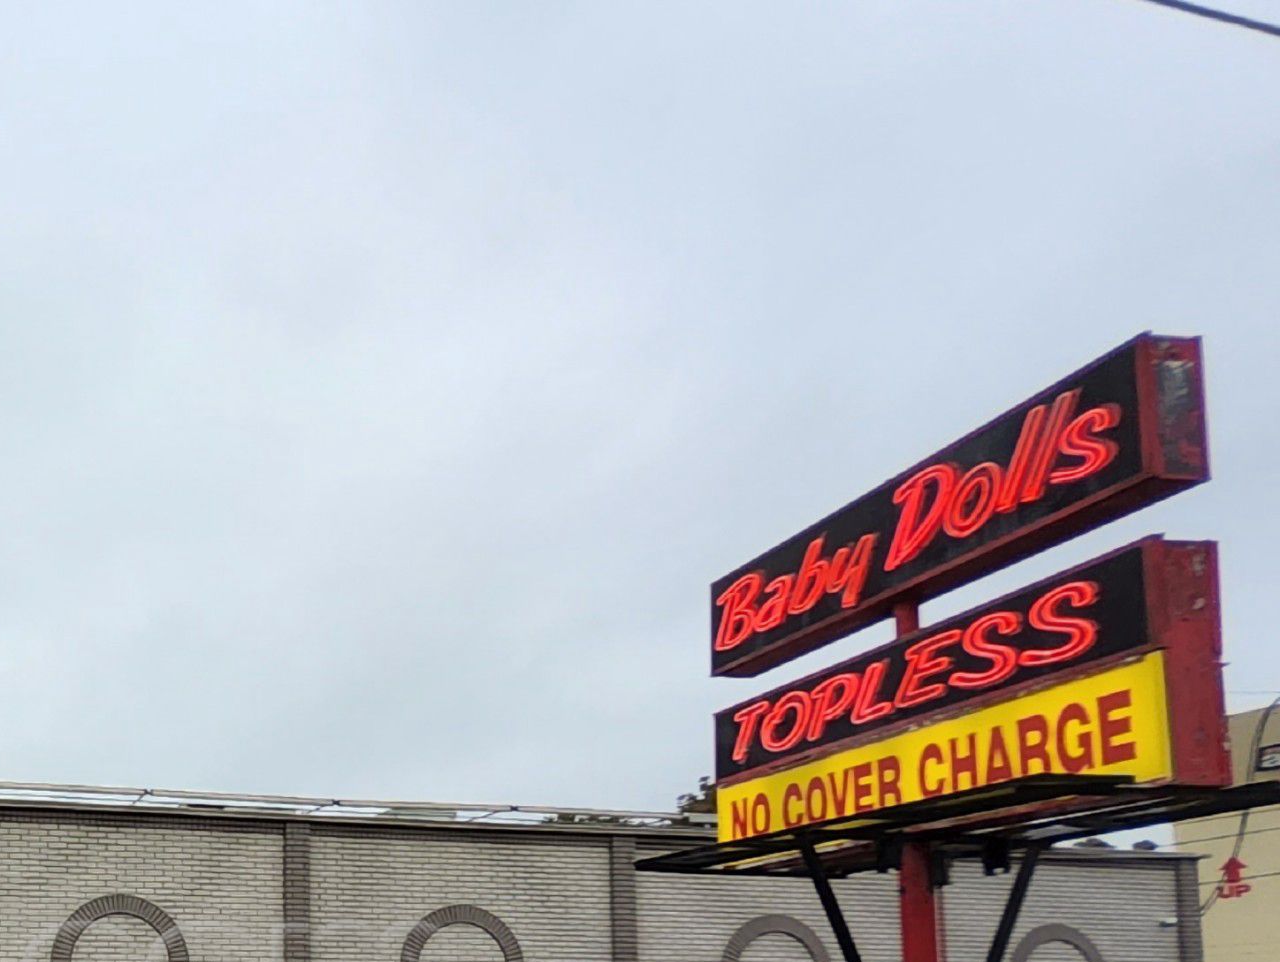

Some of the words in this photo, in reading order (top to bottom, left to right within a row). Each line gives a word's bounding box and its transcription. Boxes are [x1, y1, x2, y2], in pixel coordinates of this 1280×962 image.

[714, 531, 878, 651] Baby
[883, 387, 1121, 571] Dolls
[731, 581, 1100, 763] TOPLESS
[731, 798, 772, 841] NO
[781, 758, 902, 830] COVER
[919, 689, 1136, 798] CHARGE
